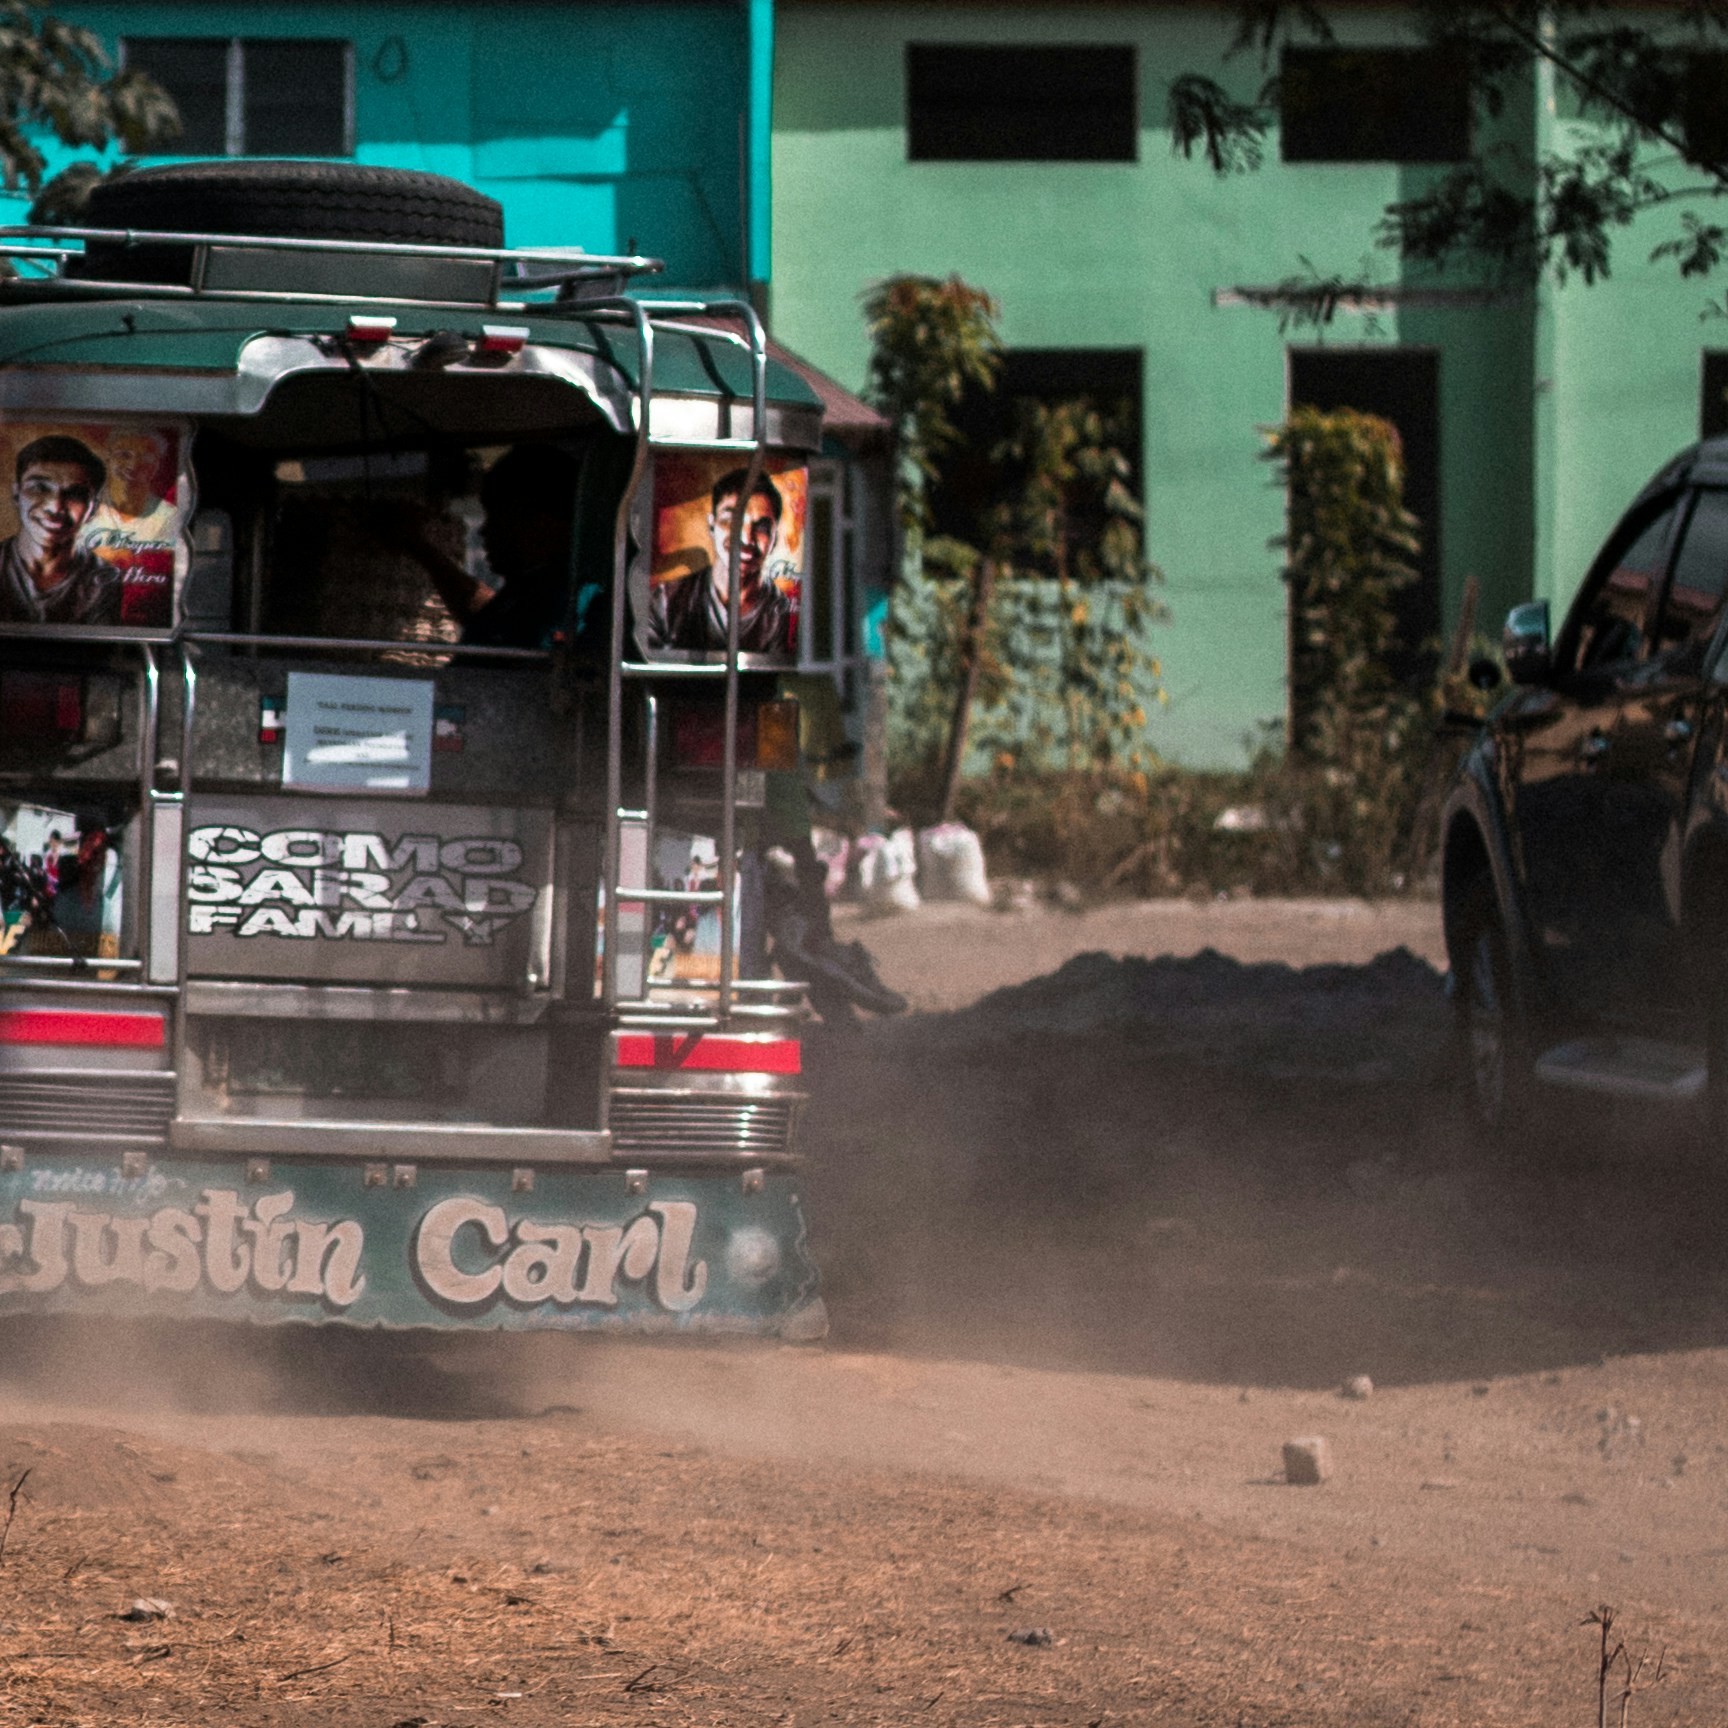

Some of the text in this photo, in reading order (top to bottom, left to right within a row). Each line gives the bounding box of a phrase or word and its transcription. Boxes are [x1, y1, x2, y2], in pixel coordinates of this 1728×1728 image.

[187, 824, 524, 873] COMO
[187, 904, 518, 946] FAMILY
[414, 1196, 709, 1311] Carl
